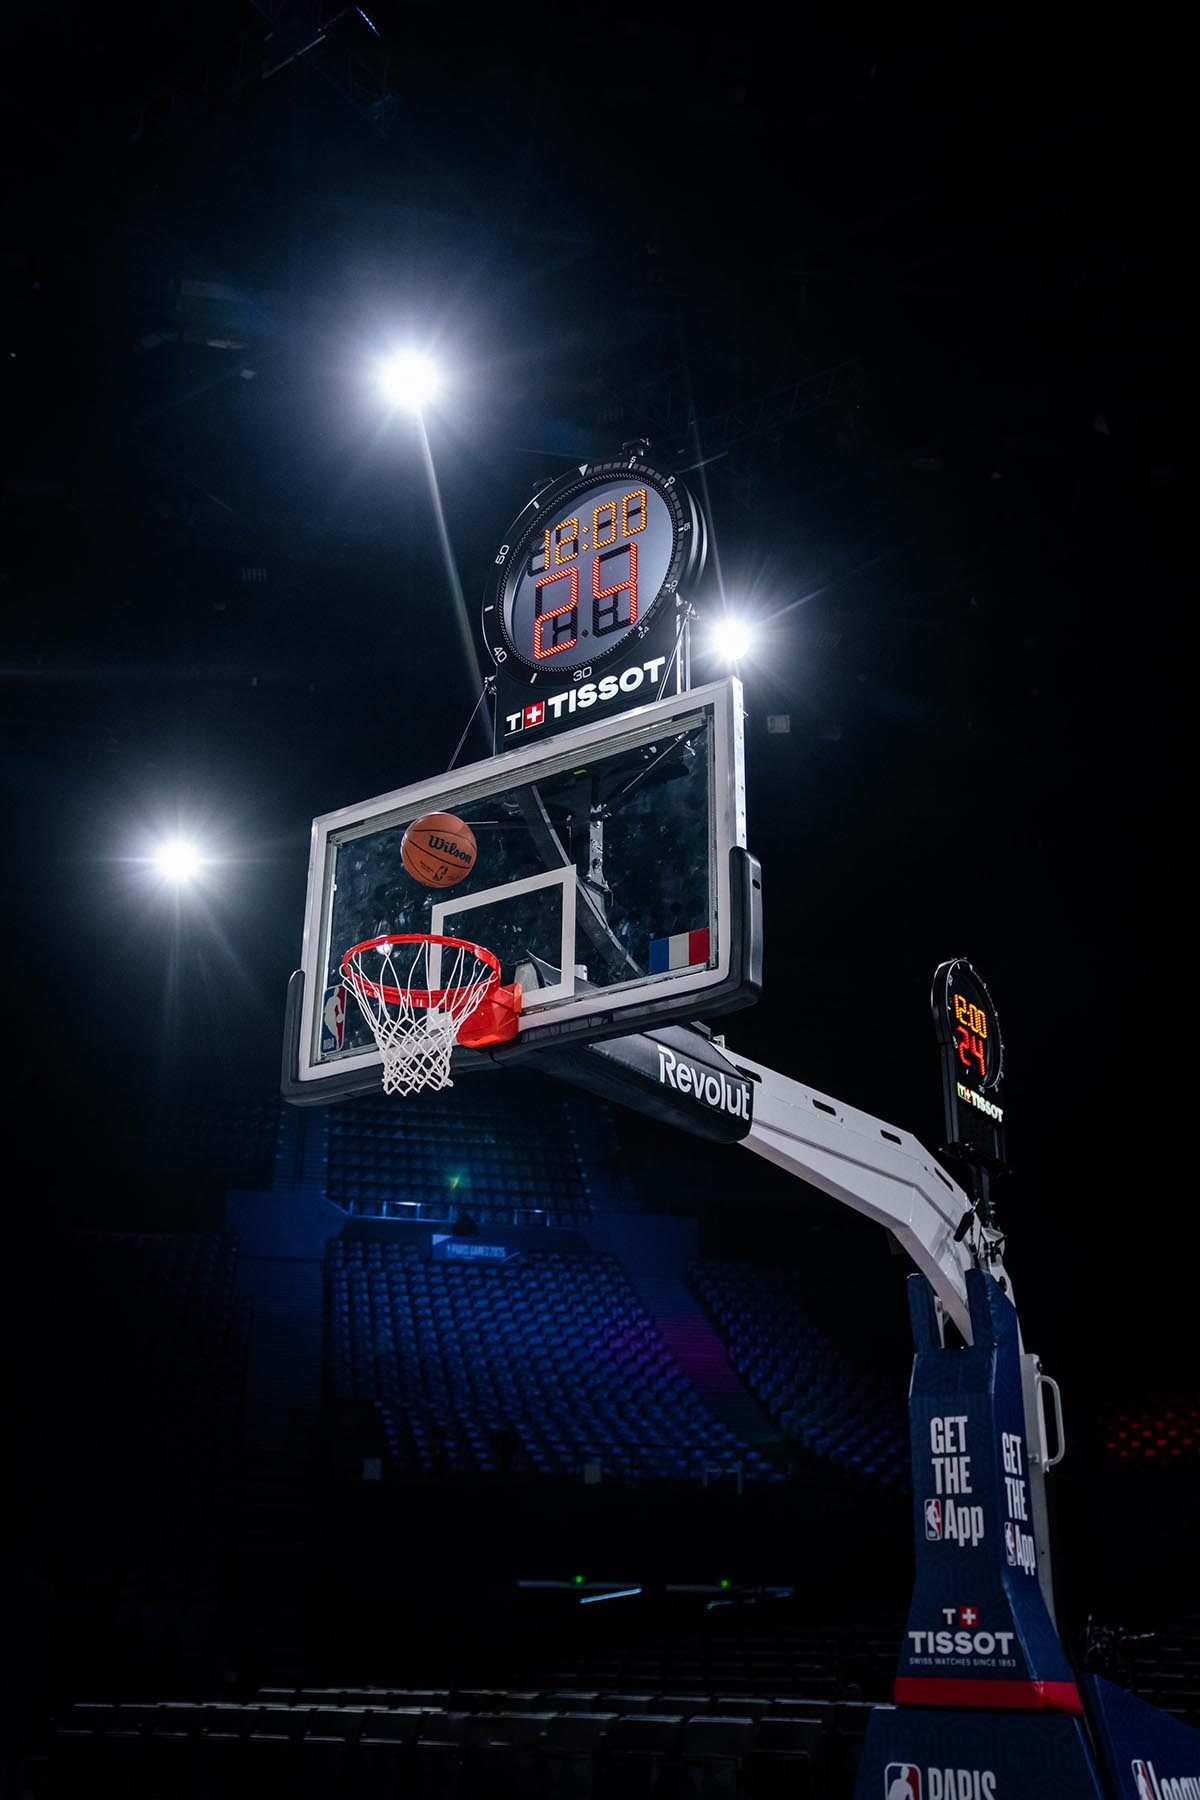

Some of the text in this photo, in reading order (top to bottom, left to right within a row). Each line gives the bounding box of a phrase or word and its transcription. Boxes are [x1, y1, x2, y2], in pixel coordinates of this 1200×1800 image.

[495, 544, 510, 565] 50
[533, 542, 639, 660] 24
[493, 647, 508, 663] 40
[572, 666, 592, 682] 30
[547, 657, 666, 719] TISSOT
[428, 834, 472, 865] Wilson
[955, 1026, 986, 1077] 24
[657, 1044, 750, 1121] Revolut
[970, 1089, 1004, 1123] TISSOT
[930, 1415, 968, 1454] GET
[1001, 1432, 1022, 1476] GET
[931, 1456, 973, 1495] THE
[1004, 1477, 1028, 1521] THE
[944, 1499, 985, 1547] App
[1015, 1525, 1036, 1576] App
[908, 1630, 1014, 1656] TISSOT
[909, 1657, 933, 1665] SWISS
[934, 1657, 971, 1666] WATCHES
[973, 1658, 995, 1667] SINCE
